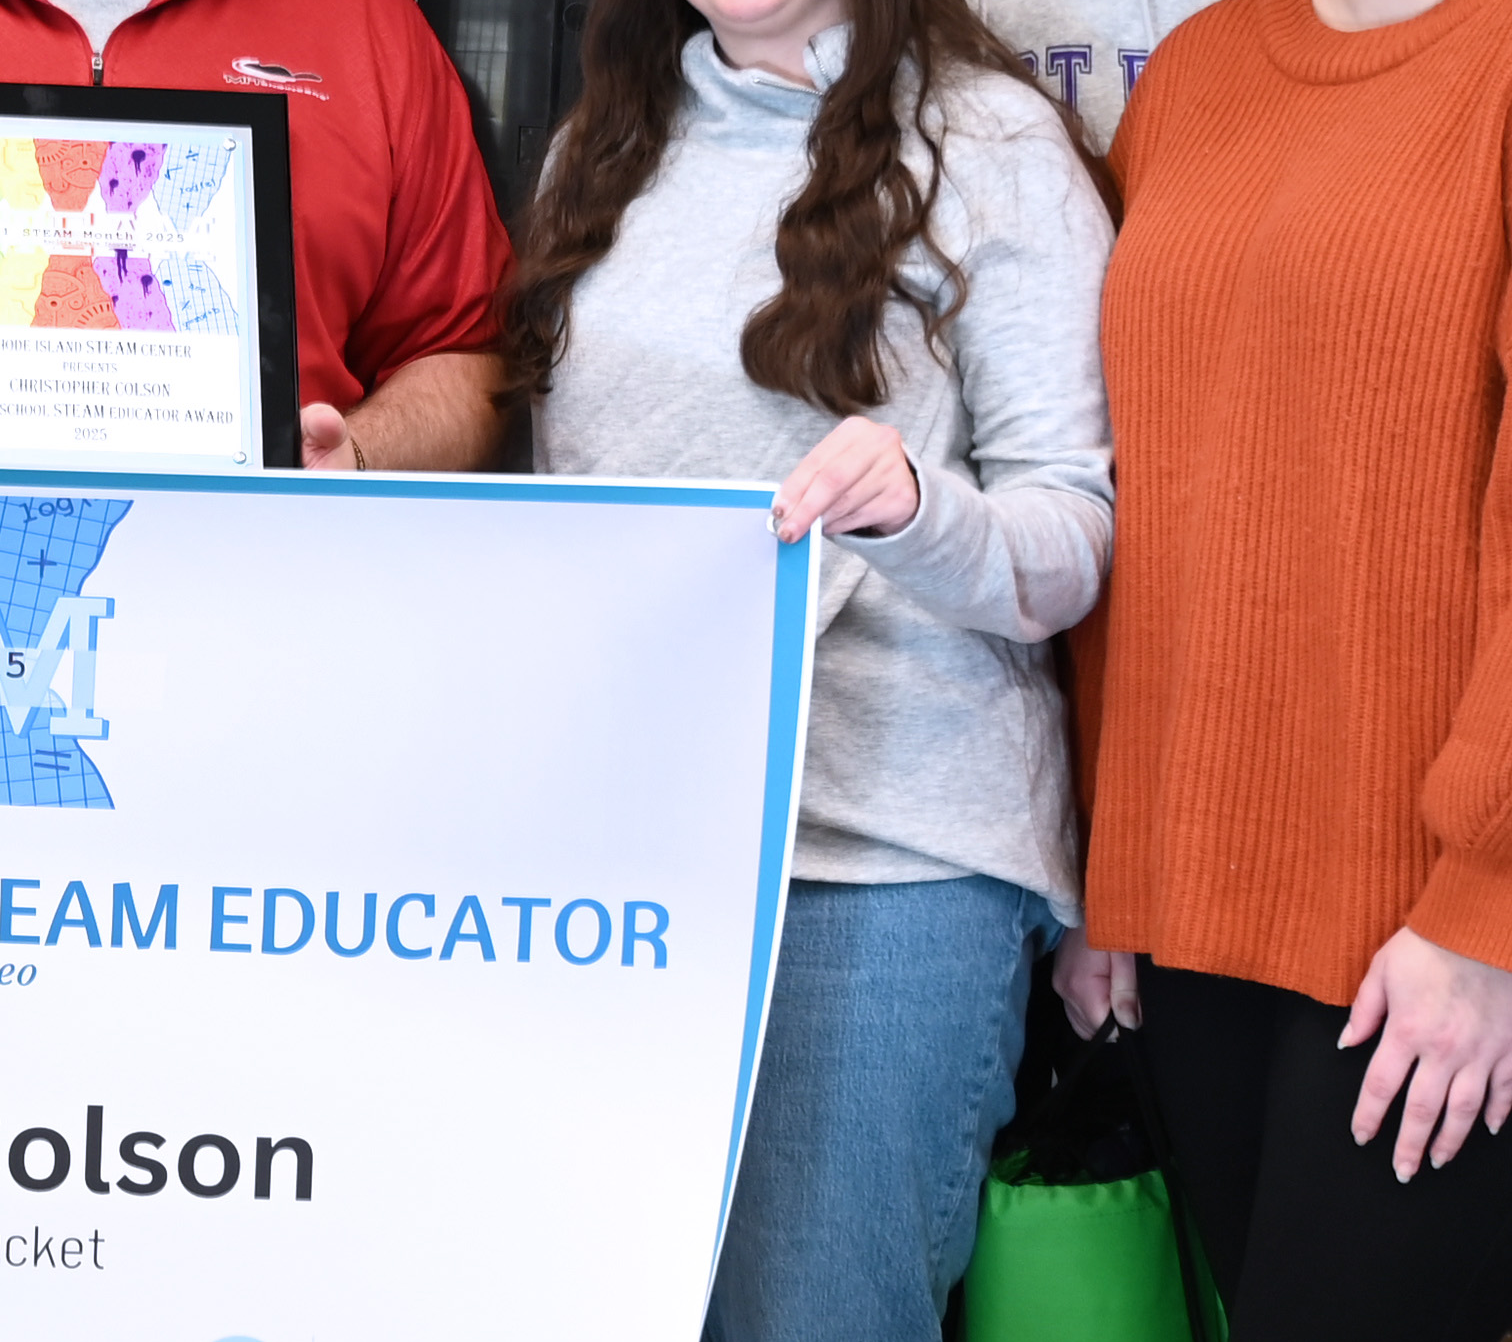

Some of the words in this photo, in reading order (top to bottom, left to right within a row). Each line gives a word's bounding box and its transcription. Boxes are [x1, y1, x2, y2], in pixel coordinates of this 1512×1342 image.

[22, 228, 72, 238] STEAM
[83, 230, 133, 240] Month
[146, 232, 185, 243] 2025
[35, 339, 82, 354] ISLAND
[86, 340, 137, 356] STEAM
[140, 343, 192, 358] CENTER
[63, 362, 118, 373] PRESENTS
[9, 378, 110, 396] CHRISTOPHER
[115, 382, 171, 397] COLSON
[0, 403, 50, 417] SCHOOL
[53, 403, 104, 419] STEAM
[109, 406, 180, 422] EDUCATOR
[184, 408, 234, 424] AWARD
[74, 427, 107, 441] 2025
[208, 885, 671, 970] EDUCATOR
